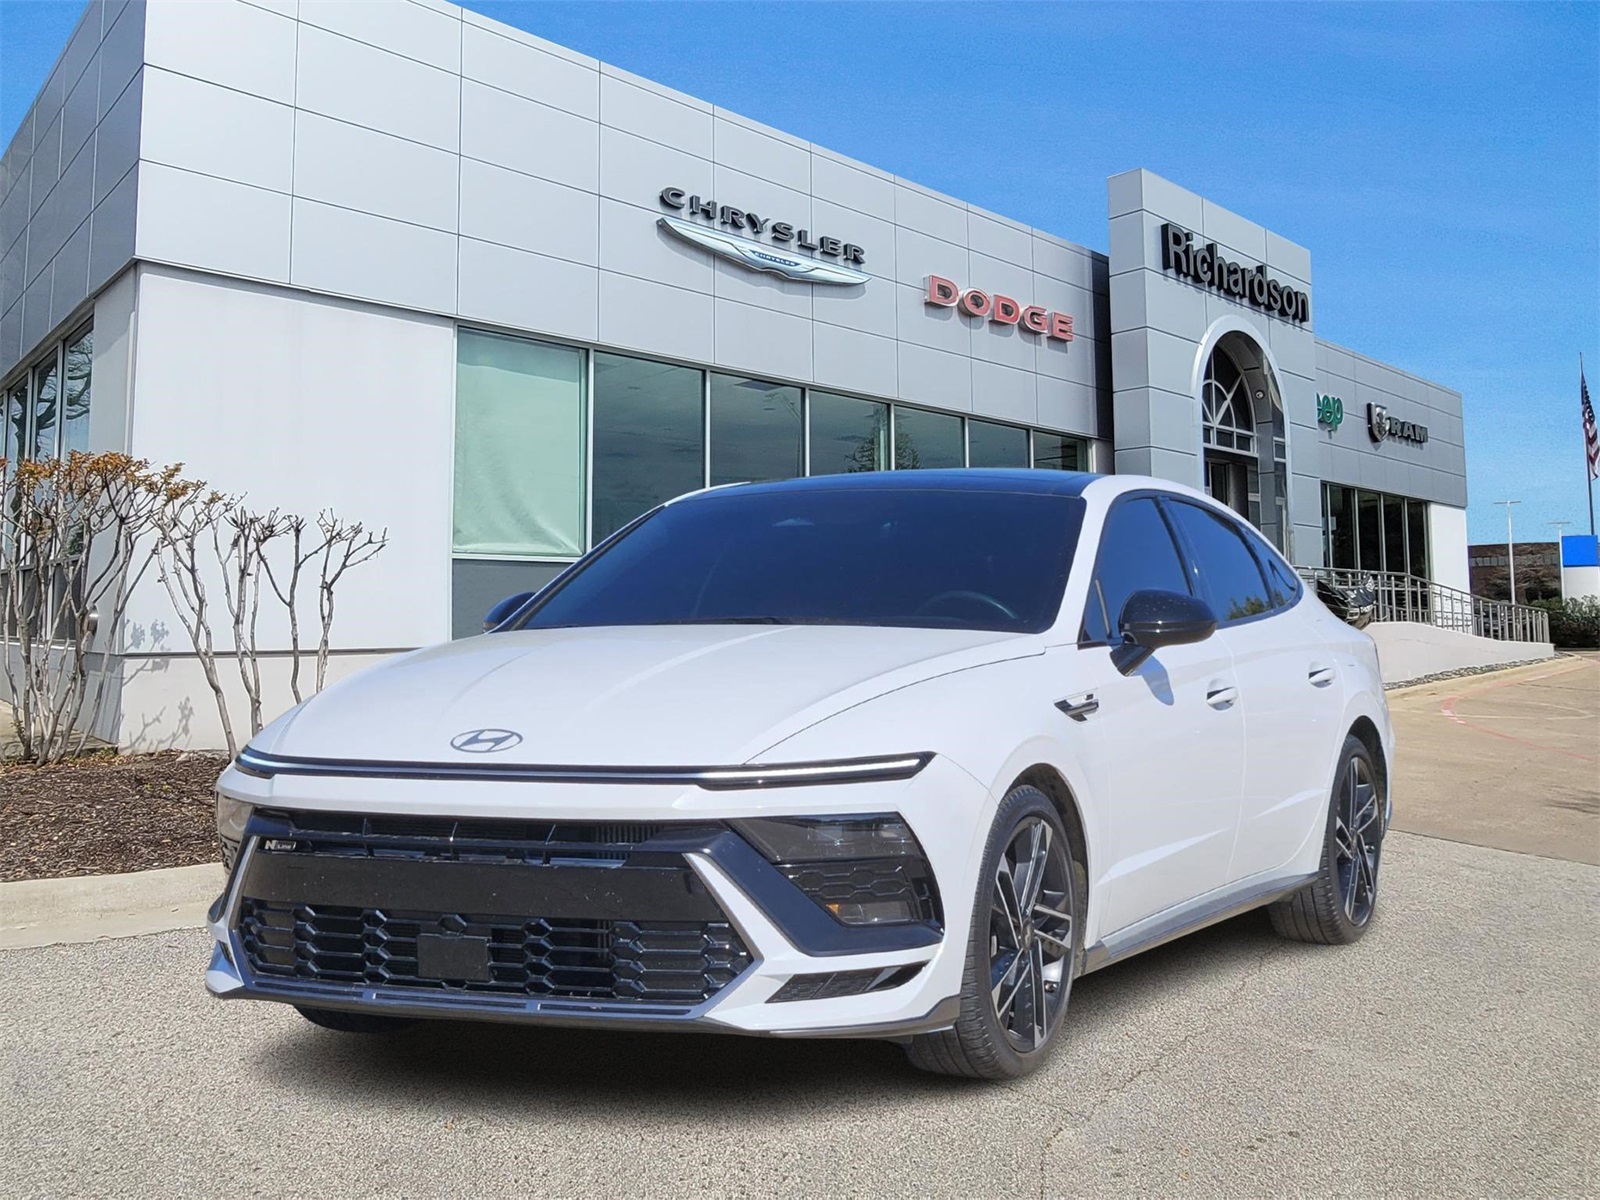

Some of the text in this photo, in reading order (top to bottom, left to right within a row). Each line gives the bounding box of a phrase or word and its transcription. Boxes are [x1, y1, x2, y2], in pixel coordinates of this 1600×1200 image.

[659, 187, 865, 264] CHRYSLER
[923, 275, 1074, 342] DODGE
[1161, 223, 1310, 323] Richardson
[1386, 417, 1429, 443] RAM
